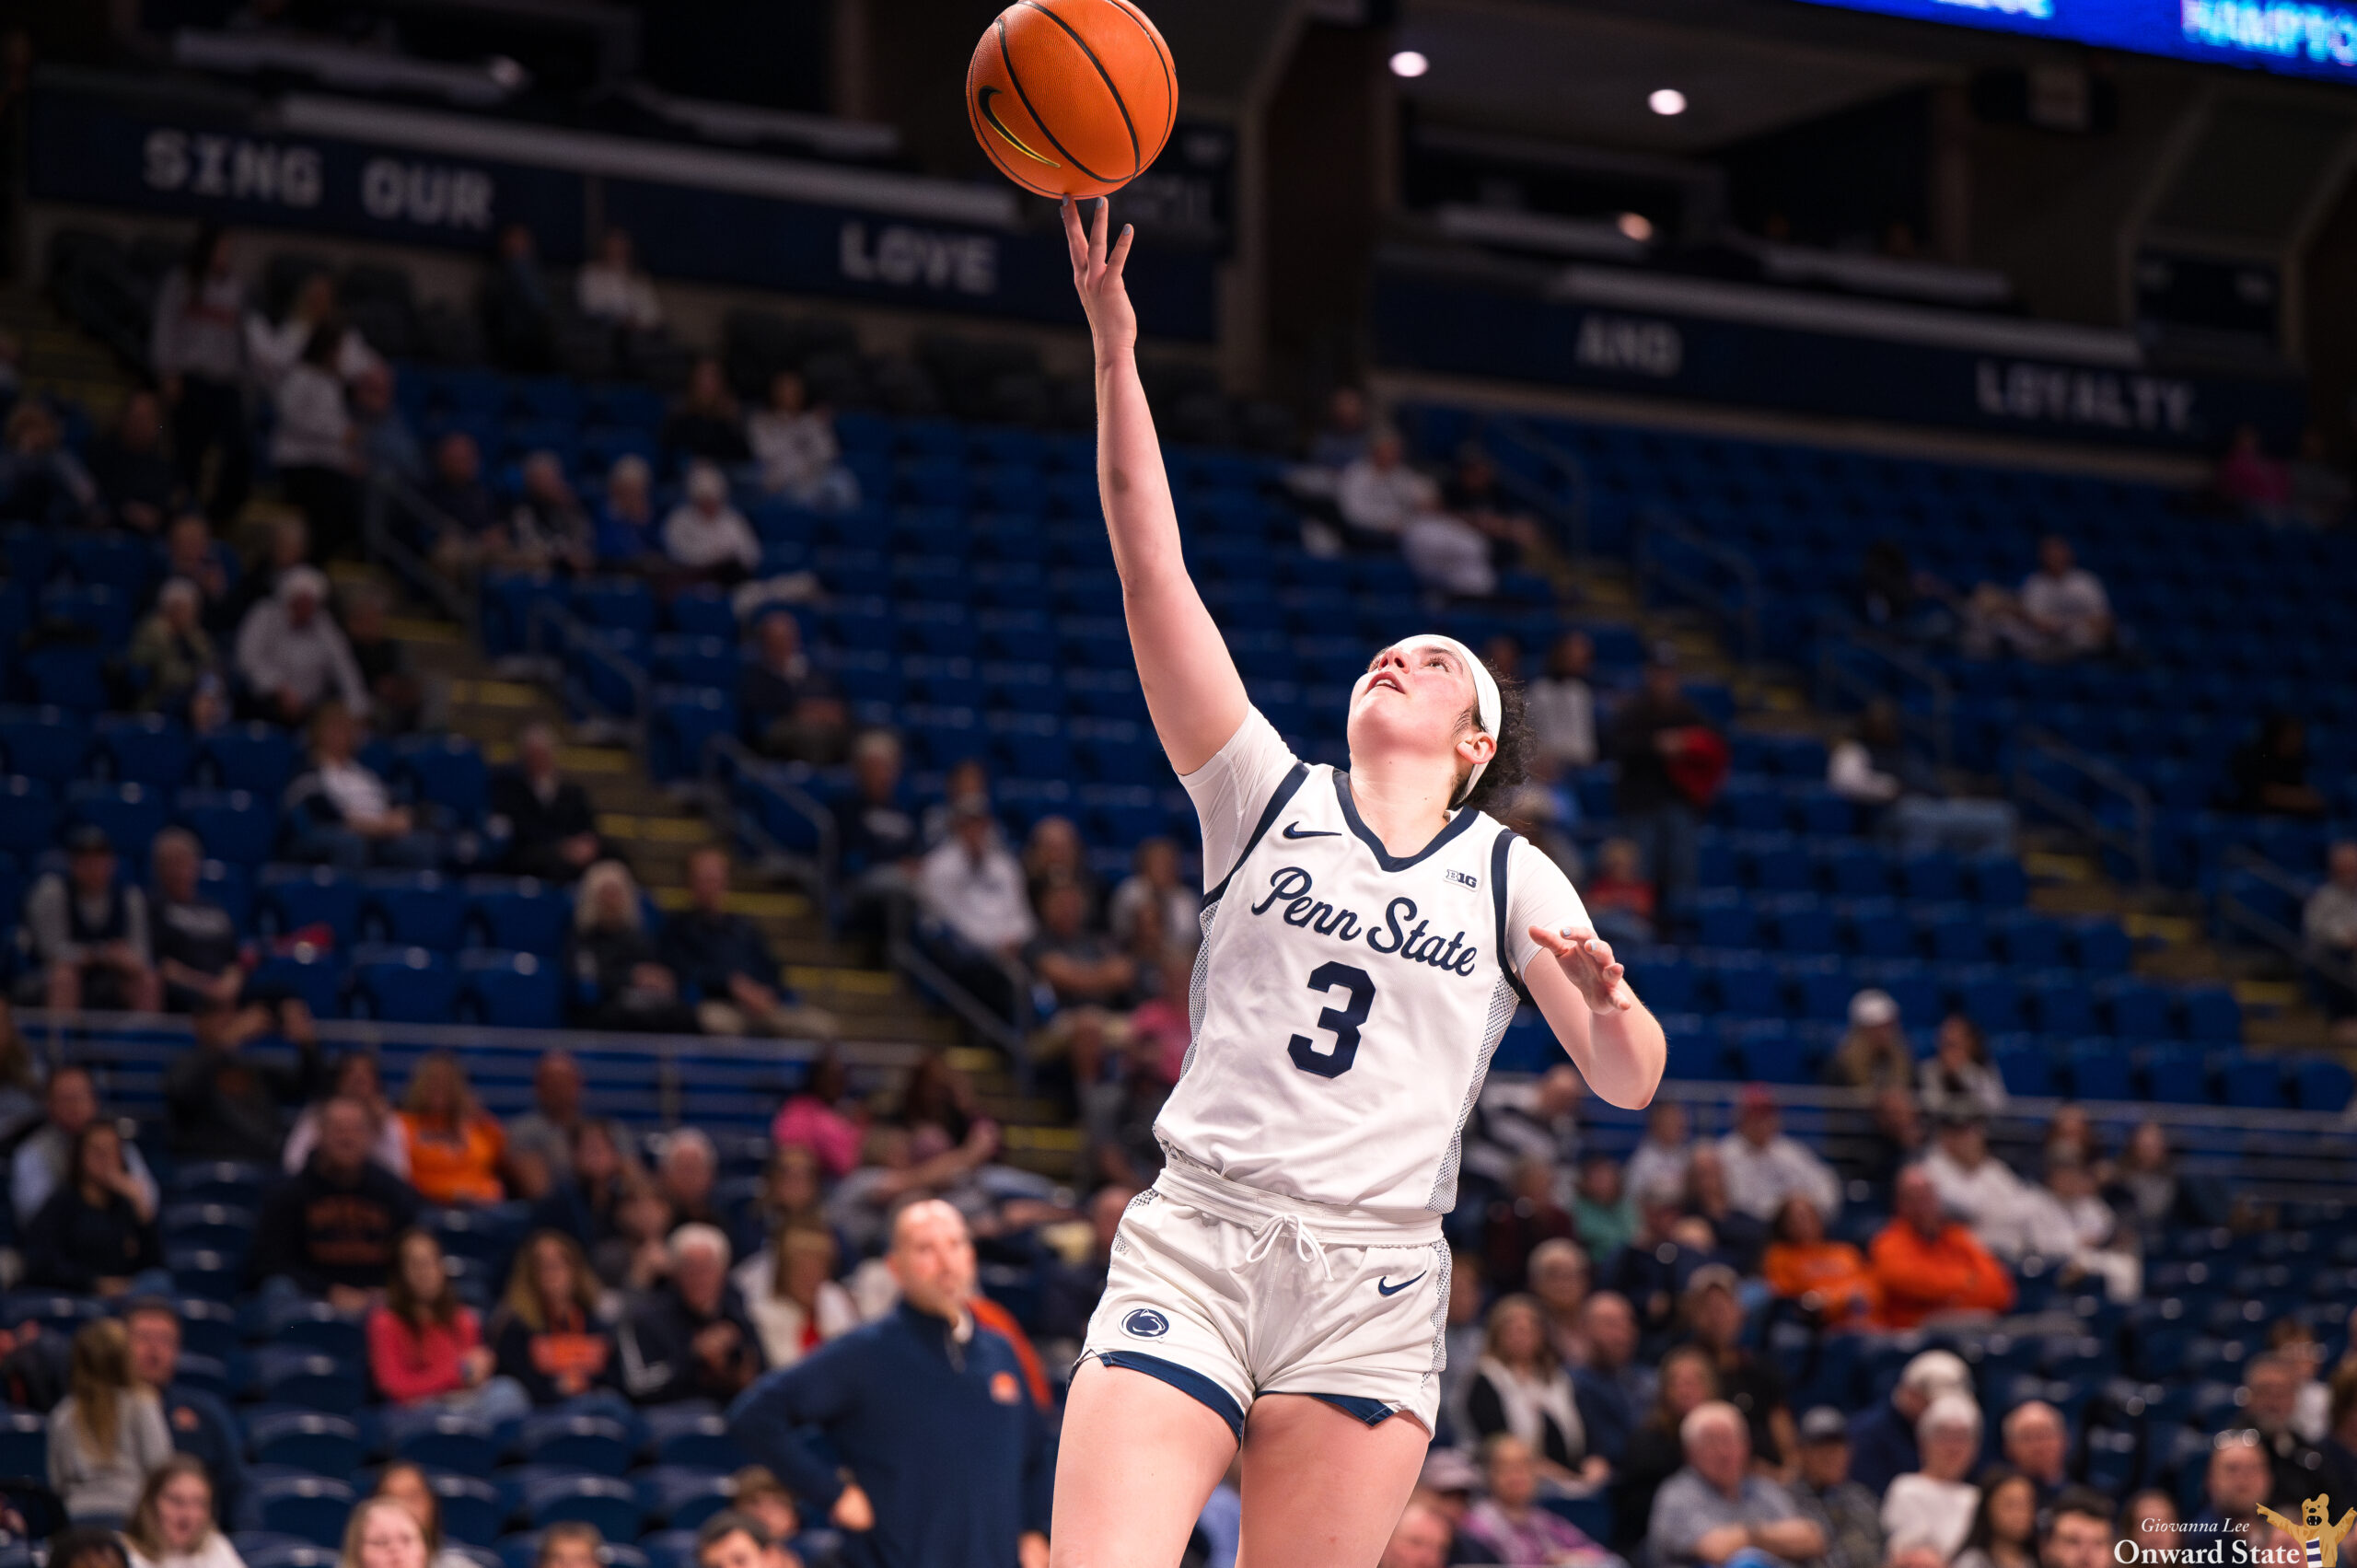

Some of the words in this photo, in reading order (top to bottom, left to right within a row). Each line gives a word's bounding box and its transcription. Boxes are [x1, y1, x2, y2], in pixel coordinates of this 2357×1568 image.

[142, 127, 323, 209] SING
[361, 155, 495, 232] OUR
[840, 220, 999, 296] LOVE
[1574, 313, 1683, 378] AND
[1976, 360, 2196, 433] LOYALTY
[1251, 866, 1362, 941] Penn
[1366, 897, 1478, 976] State
[1287, 960, 1376, 1078] 3
